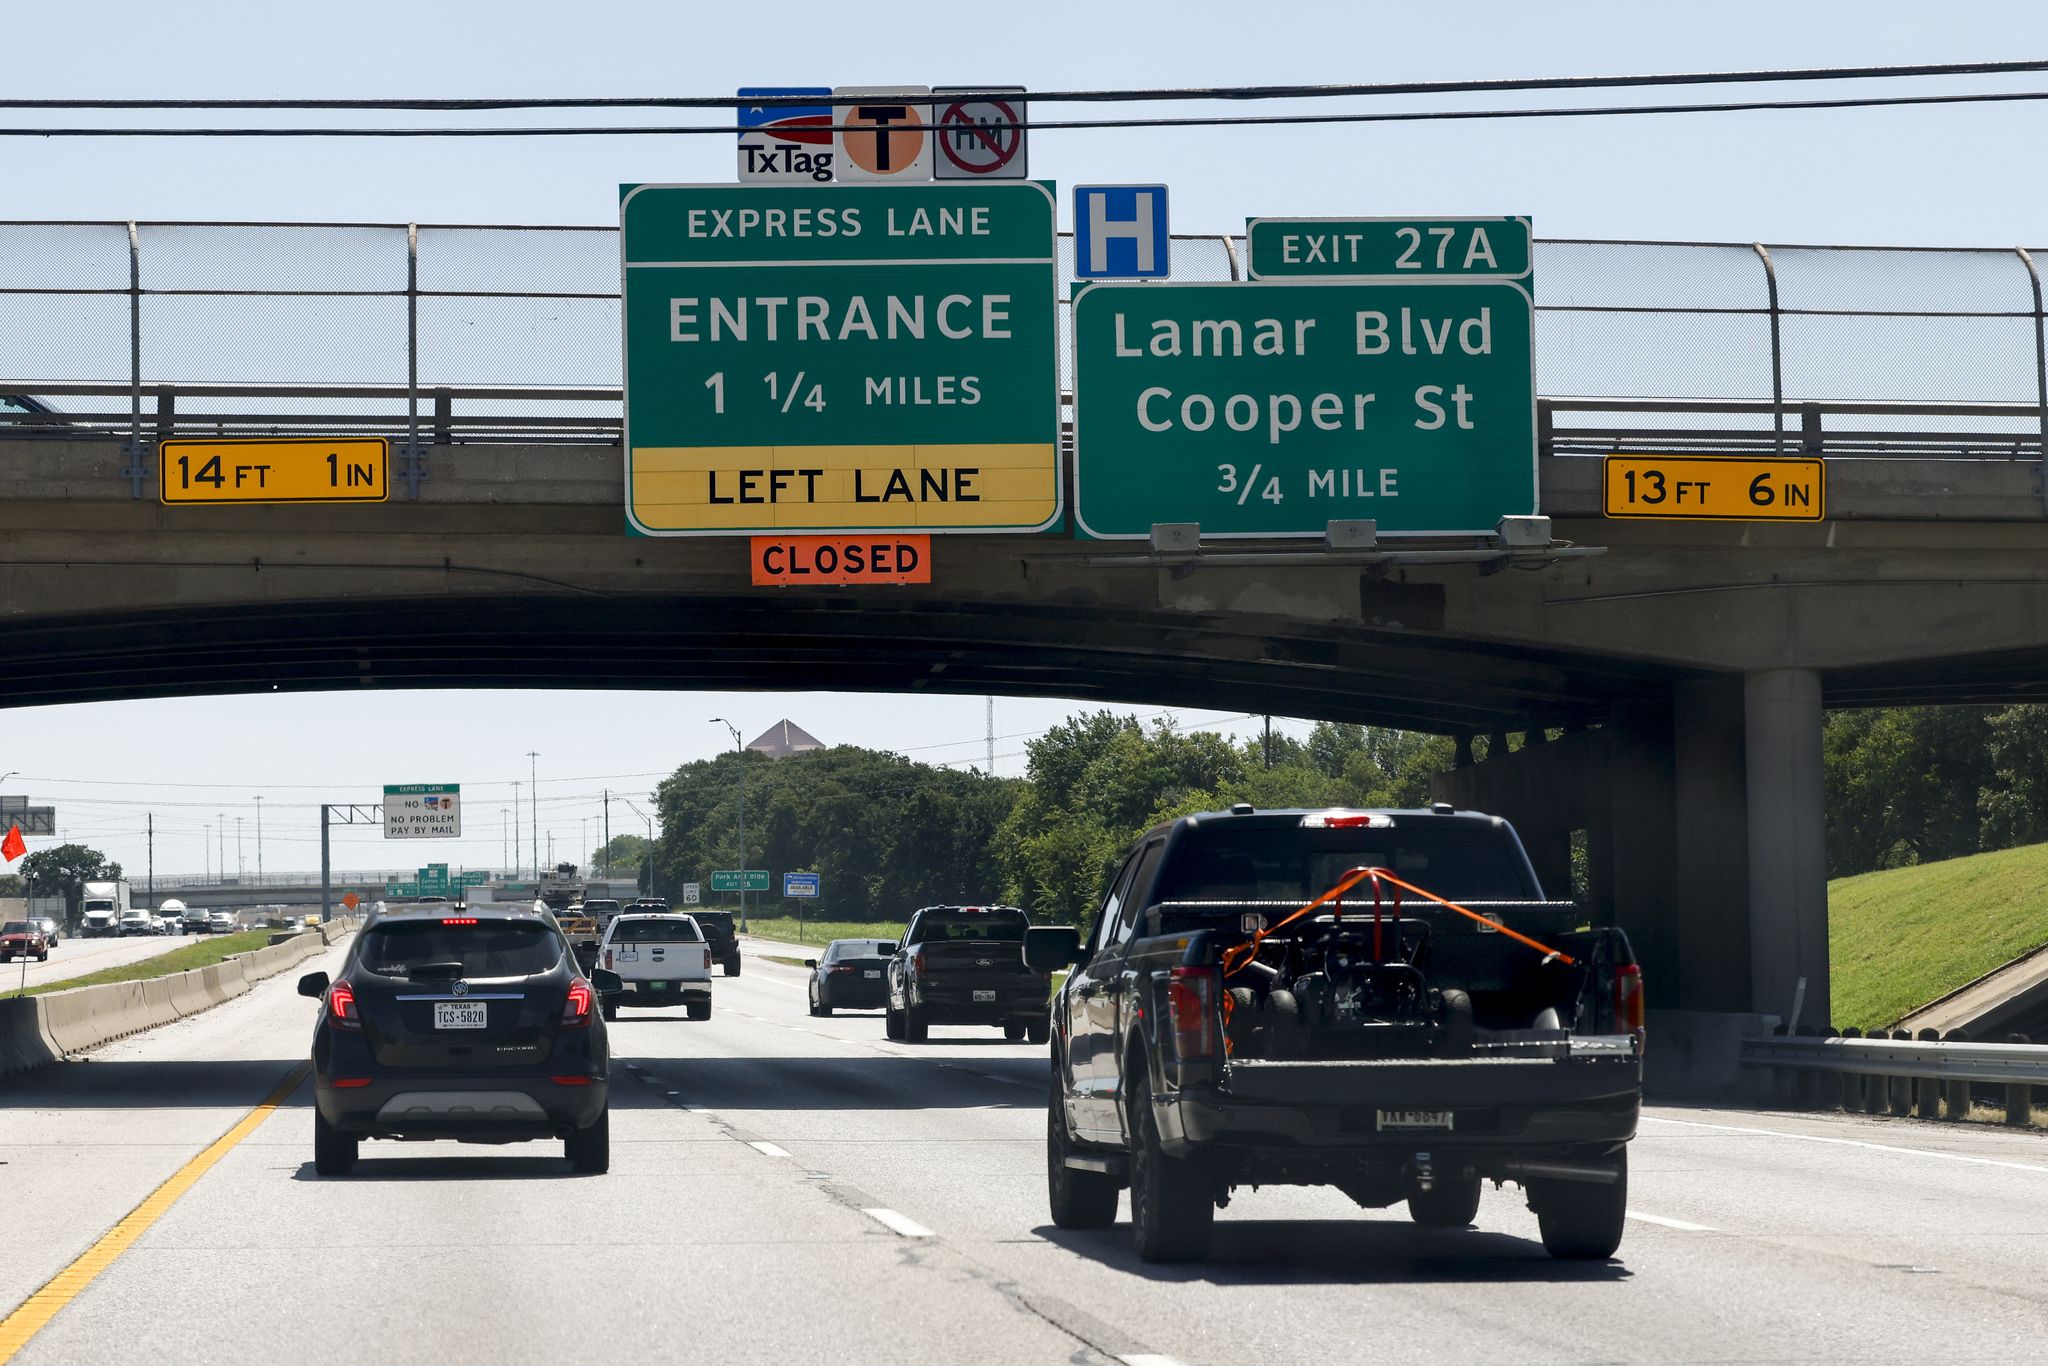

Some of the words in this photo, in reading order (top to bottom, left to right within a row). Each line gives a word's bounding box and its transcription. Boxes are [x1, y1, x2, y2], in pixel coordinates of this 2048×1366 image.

[858, 104, 906, 170] T
[738, 144, 834, 182] TxTag
[688, 208, 862, 238] EXPRESS
[888, 207, 990, 236] LANE
[1089, 192, 1154, 272] H
[1282, 234, 1364, 264] EXIT
[1394, 228, 1498, 268] 27A
[670, 294, 1012, 342] ENTRANCE
[1114, 312, 1316, 358] Lamar
[1356, 306, 1492, 356] Blvd
[704, 372, 725, 414] 1
[865, 376, 982, 406] MILES
[1136, 386, 1376, 444] Cooper
[1414, 384, 1474, 430] St
[178, 456, 226, 489] 14
[236, 465, 270, 488] FT
[326, 454, 338, 487] 1
[347, 464, 373, 486] IN
[708, 469, 824, 505] LEFT
[855, 467, 980, 502] LANE
[1216, 464, 1284, 506] 3/4
[1308, 468, 1398, 498] MILE
[1624, 470, 1667, 504] 13
[1676, 482, 1711, 504] FT
[1749, 472, 1776, 506] 6
[1784, 484, 1810, 506] IN
[762, 544, 919, 575] CLOSED
[390, 816, 405, 824] NO
[410, 814, 454, 823] PROBLEM
[404, 800, 419, 808] NO
[391, 826, 410, 834] PAY
[432, 826, 454, 834] MAIL
